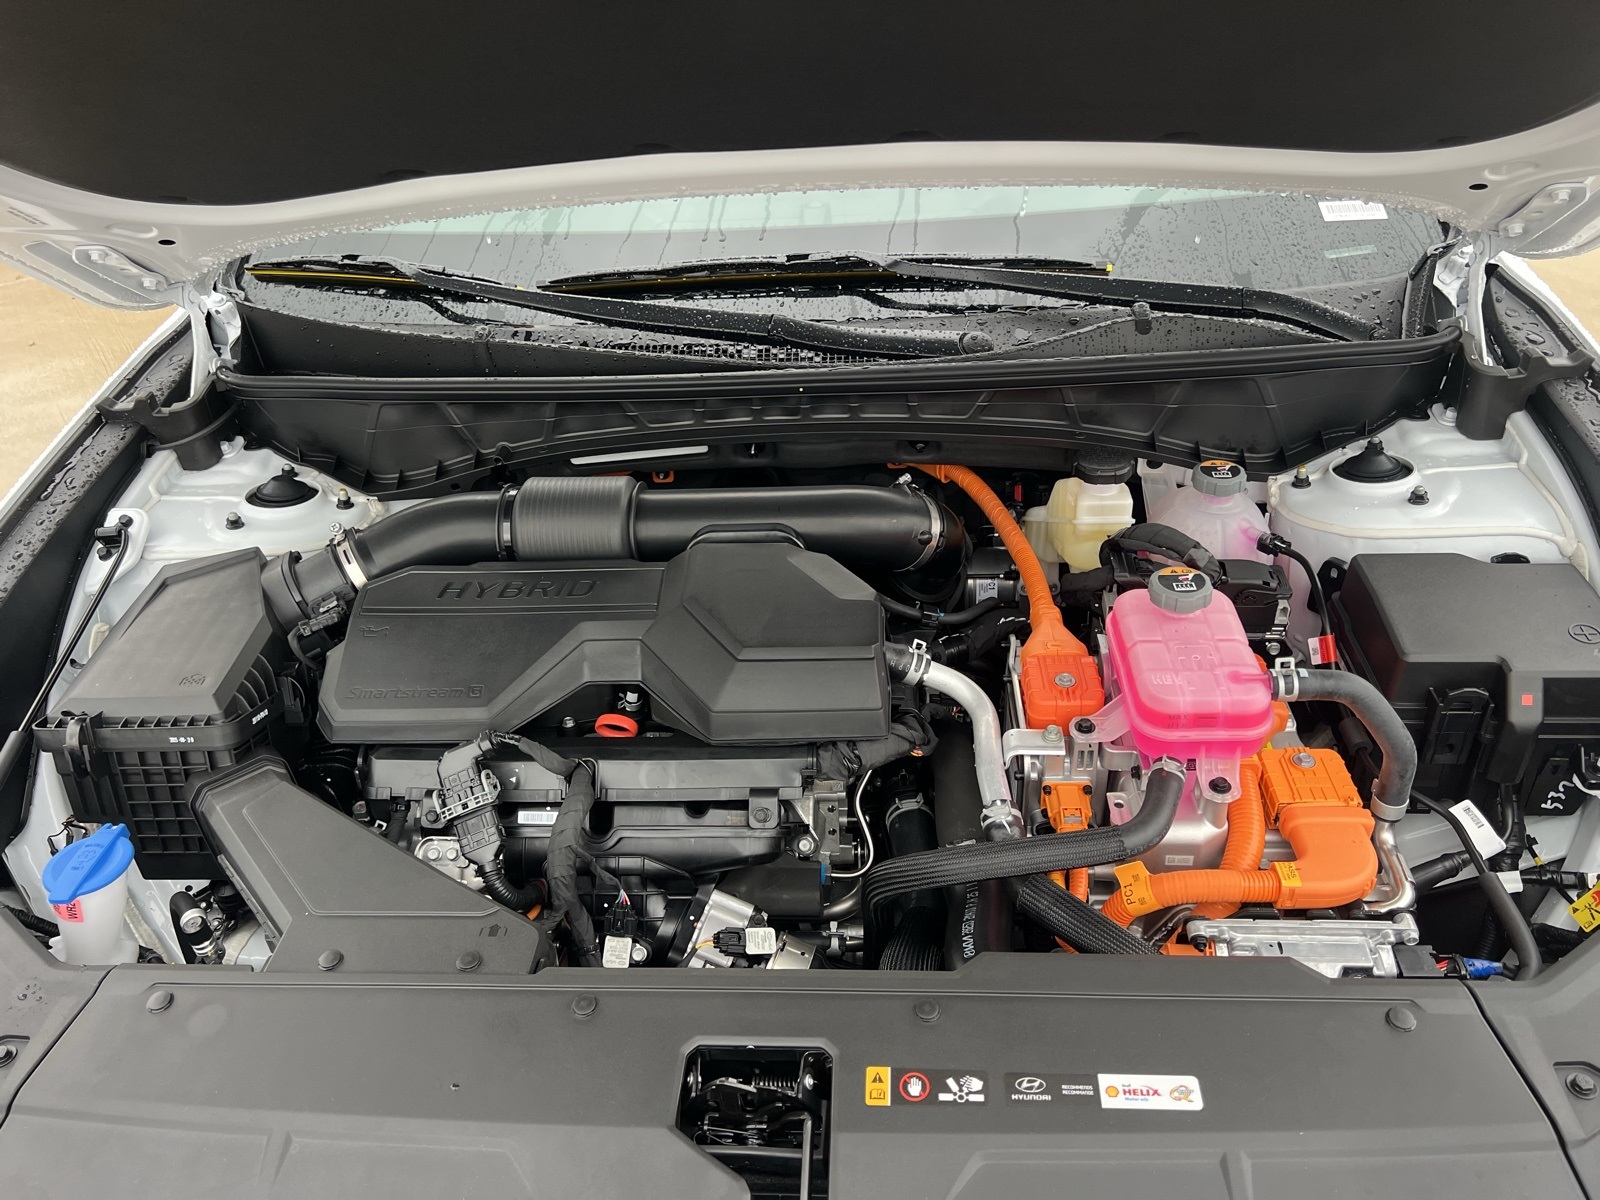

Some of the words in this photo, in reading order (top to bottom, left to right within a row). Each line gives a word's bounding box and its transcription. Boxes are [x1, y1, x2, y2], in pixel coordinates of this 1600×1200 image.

[436, 579, 598, 600] HYBRID
[345, 685, 465, 699] Smartstream
[1123, 883, 1136, 905] PC1
[1011, 1093, 1052, 1101] HYUNDAI
[1122, 1087, 1162, 1096] HELIX
